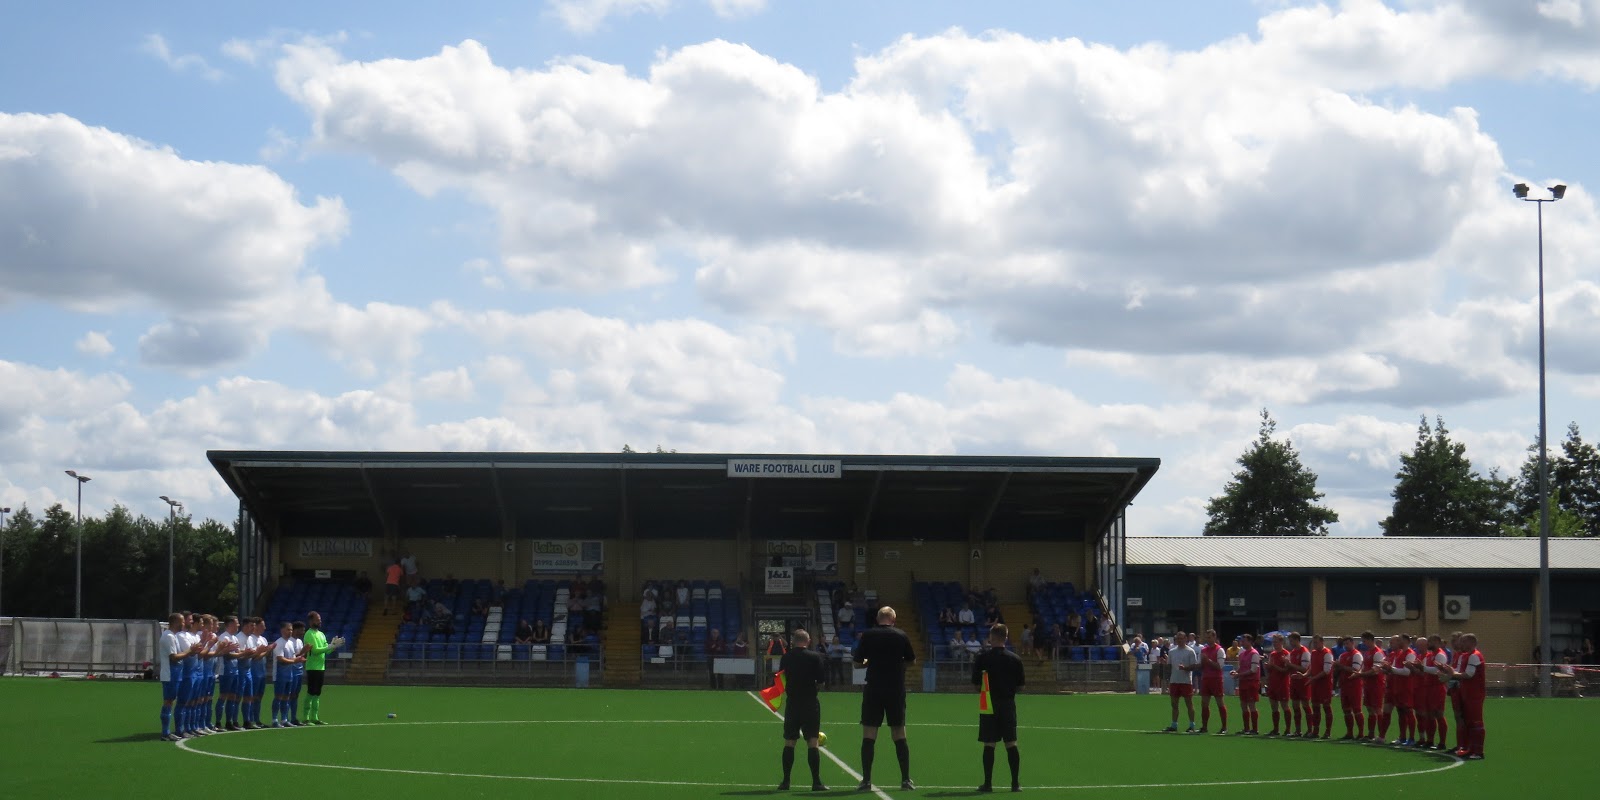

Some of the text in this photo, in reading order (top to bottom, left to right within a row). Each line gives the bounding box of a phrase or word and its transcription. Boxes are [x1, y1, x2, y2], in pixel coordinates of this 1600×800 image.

[734, 464, 835, 473] WARE FOOTBALL CLUB
[303, 540, 369, 552] MERCURY
[506, 543, 513, 552] C
[857, 547, 864, 556] B
[972, 550, 980, 559] A
